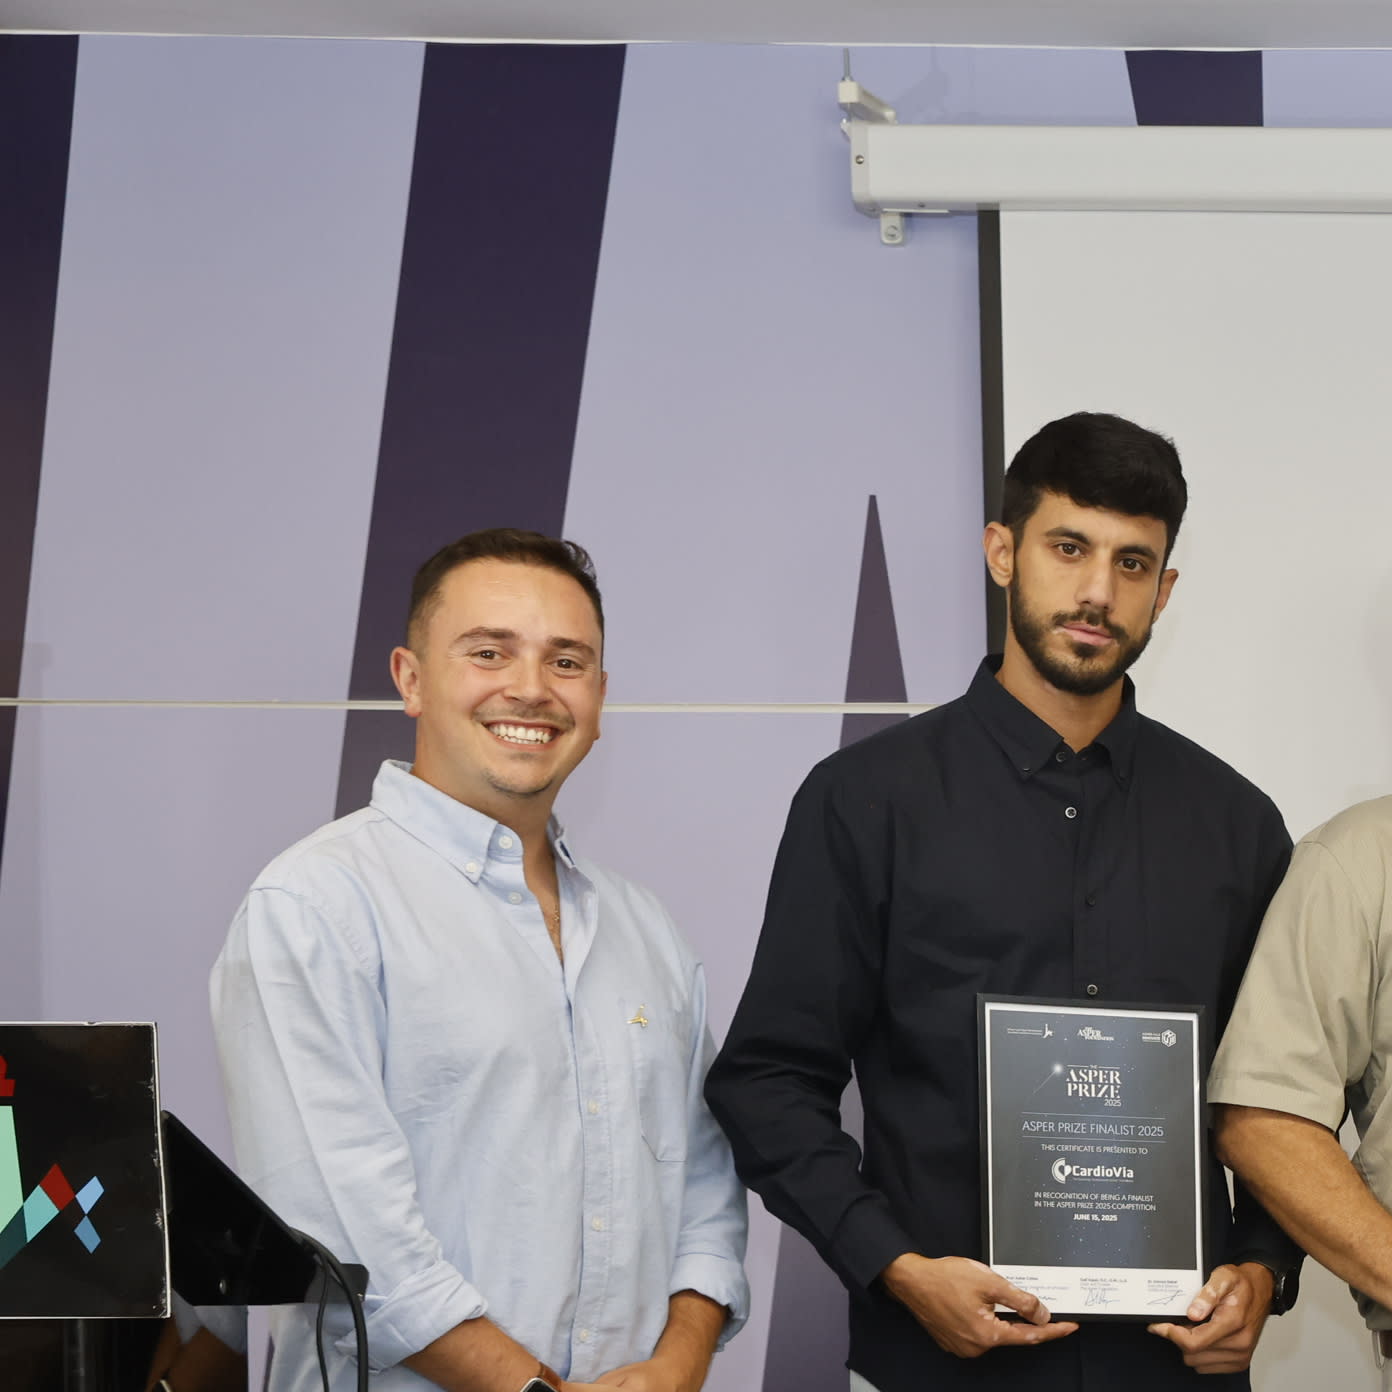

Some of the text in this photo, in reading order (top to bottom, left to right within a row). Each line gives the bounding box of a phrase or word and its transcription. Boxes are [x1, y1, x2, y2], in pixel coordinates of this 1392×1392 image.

[1066, 1069, 1122, 1084] ASPER
[1067, 1083, 1120, 1098] PRIZE
[1022, 1121, 1164, 1137] ASPER PRIZE FINALIST 2025
[1072, 1165, 1134, 1178] CardioVia
